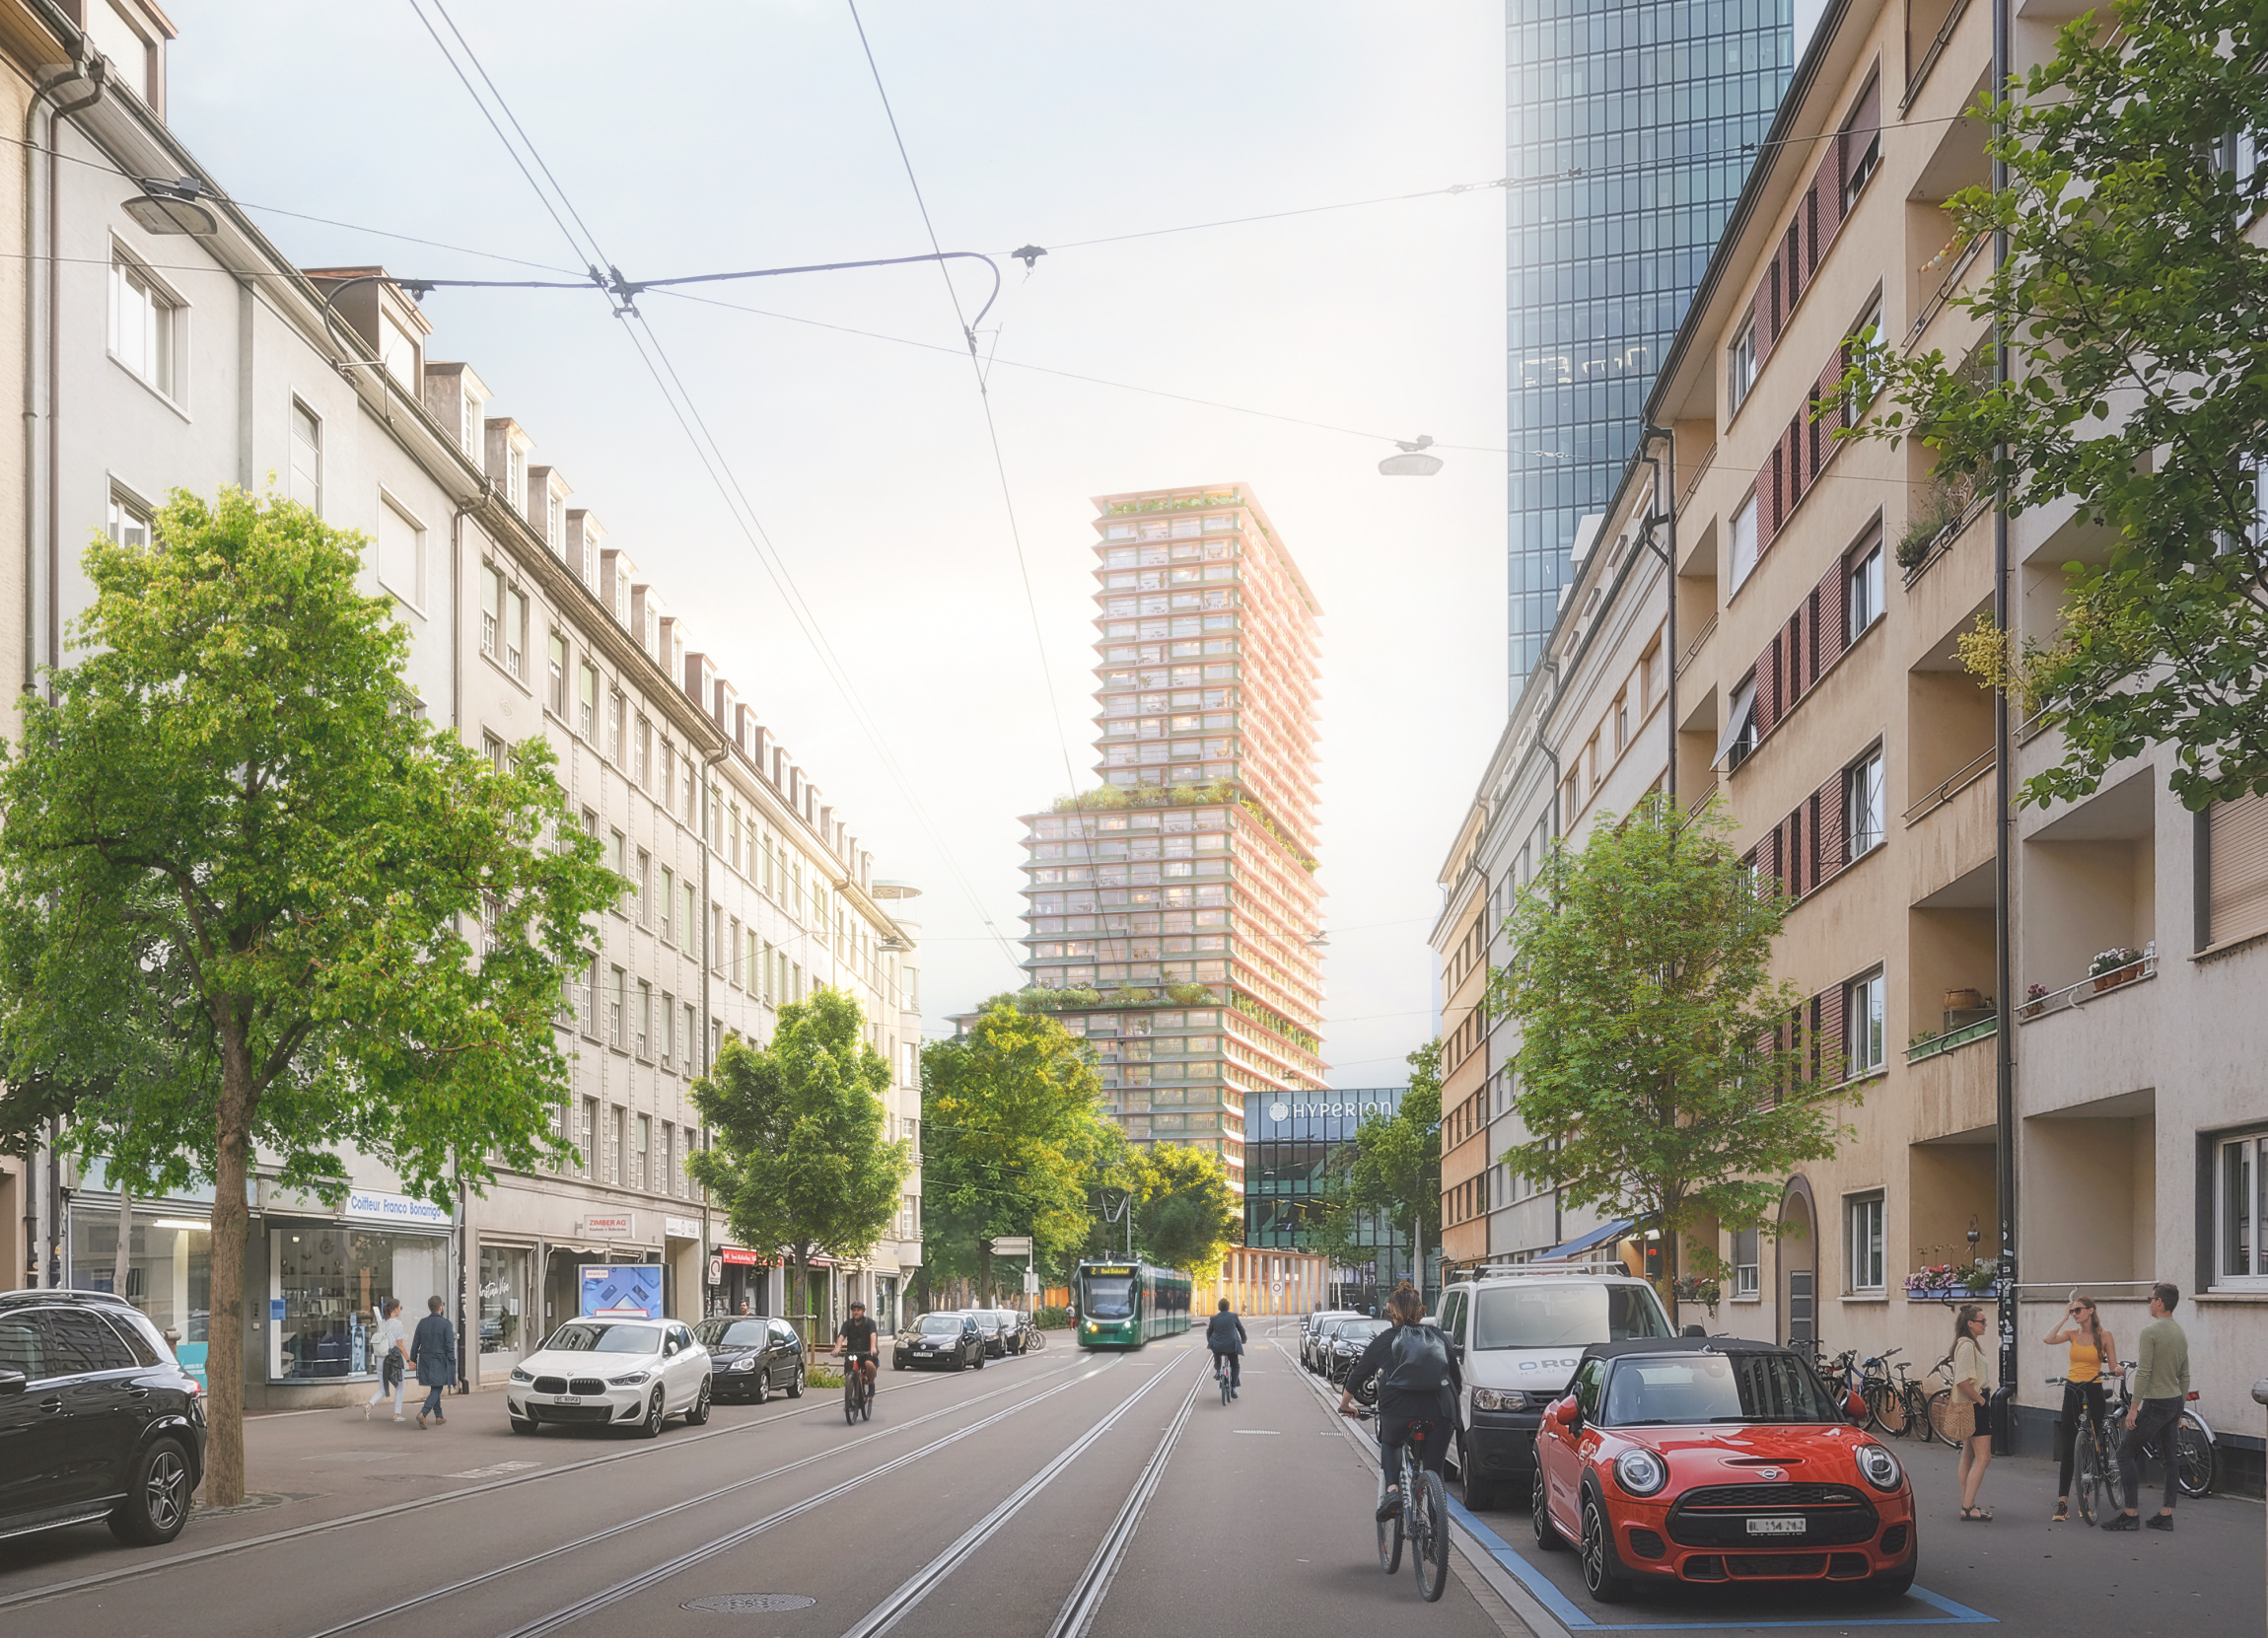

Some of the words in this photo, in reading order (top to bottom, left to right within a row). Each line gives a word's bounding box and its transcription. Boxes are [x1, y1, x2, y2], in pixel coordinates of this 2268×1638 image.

[351, 1195, 381, 1211] Coiffeur
[383, 1199, 407, 1214] Franco
[410, 1202, 441, 1220] Bonarrigo
